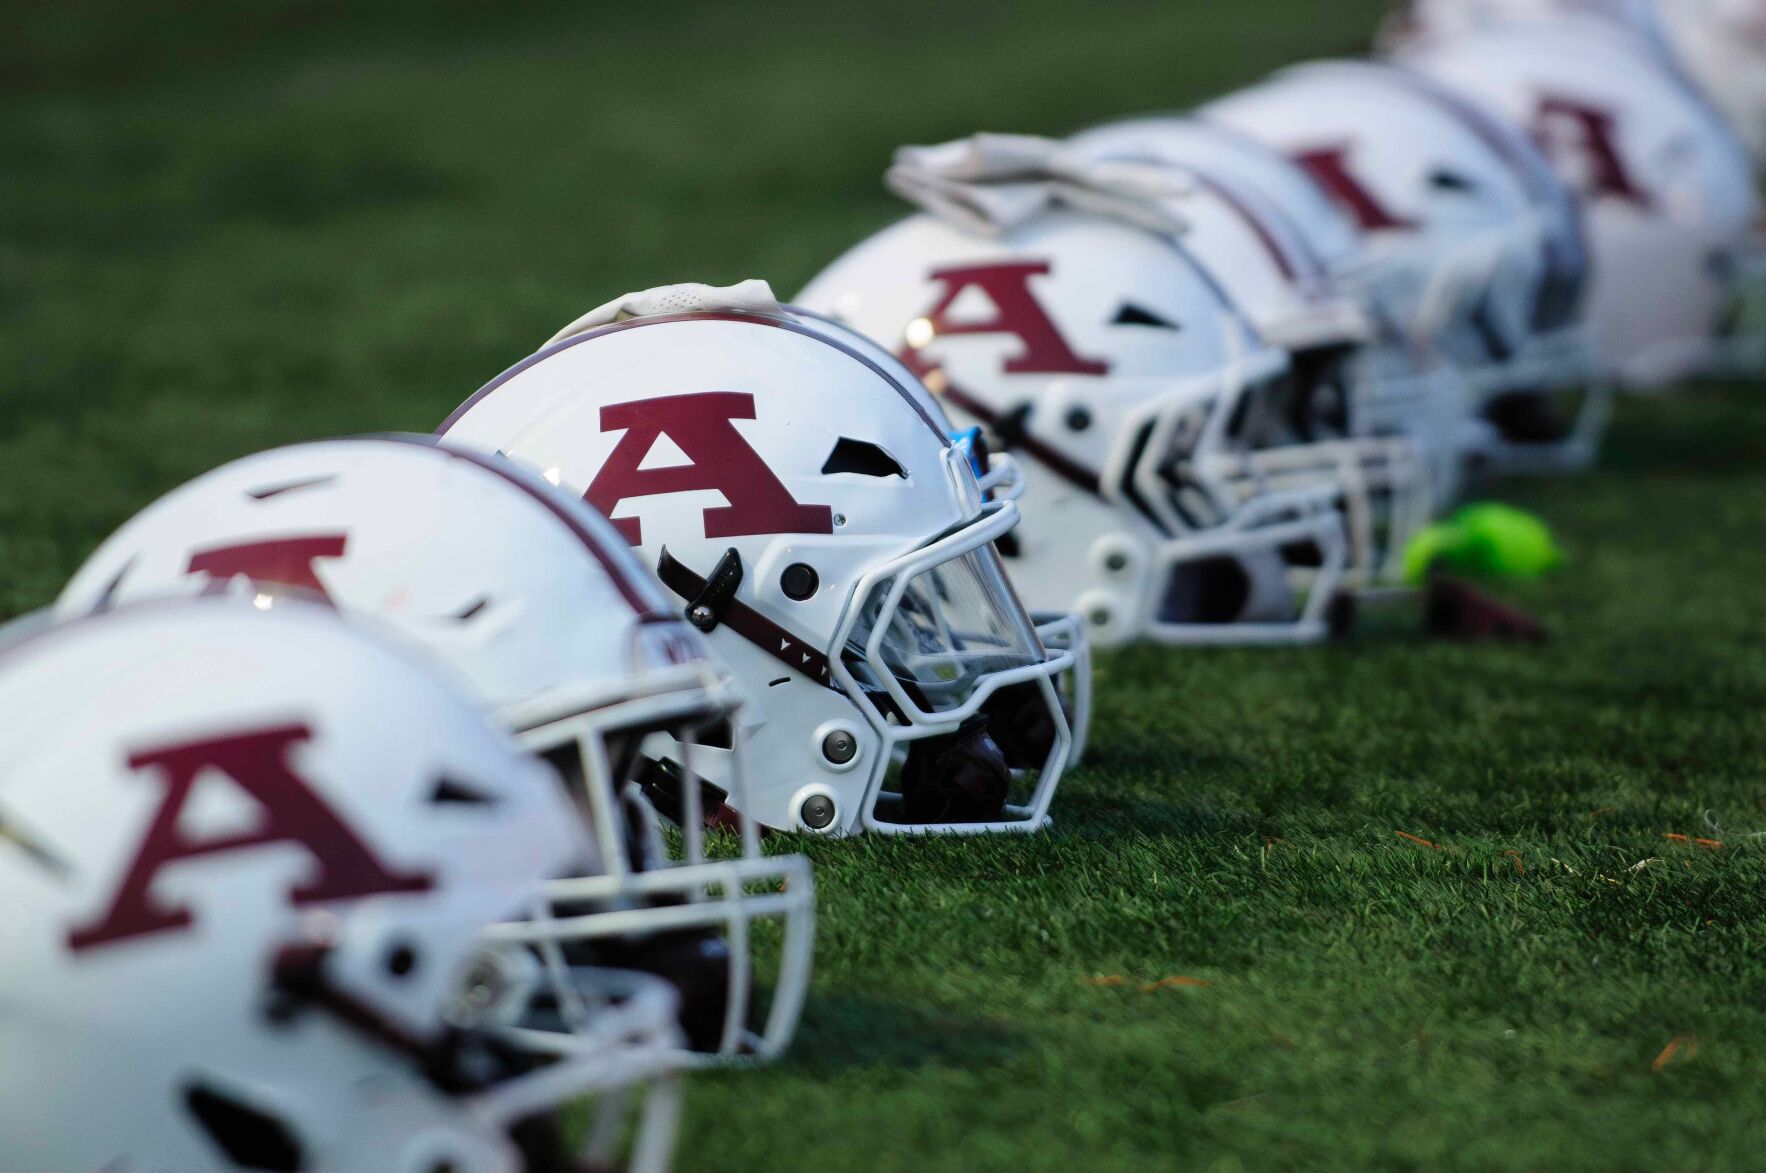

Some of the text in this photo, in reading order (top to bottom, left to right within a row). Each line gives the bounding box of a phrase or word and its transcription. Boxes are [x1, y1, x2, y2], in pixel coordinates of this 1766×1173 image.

[896, 258, 1111, 378] A
[581, 390, 833, 547] A
[67, 722, 435, 953] A
